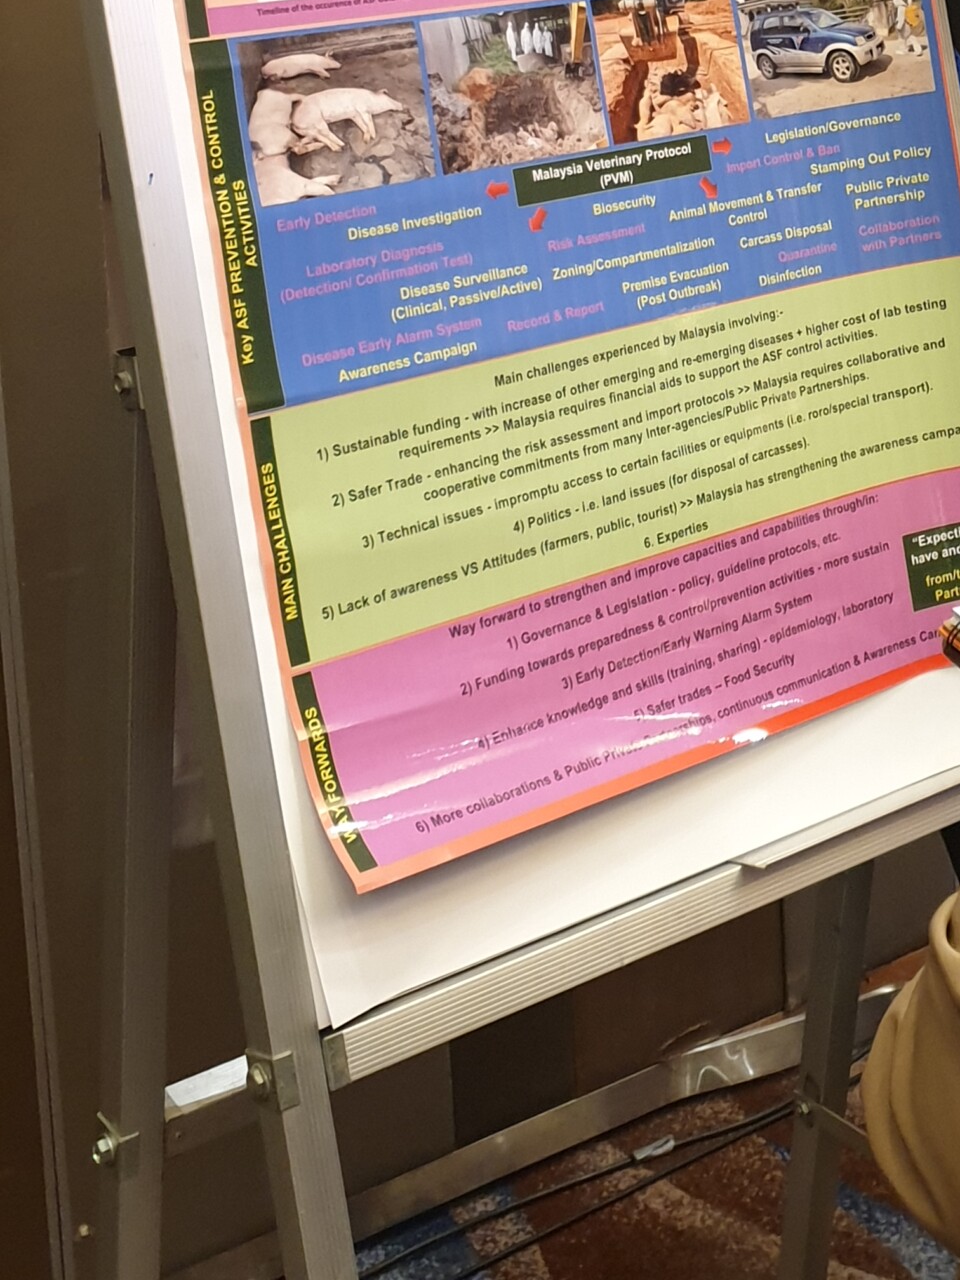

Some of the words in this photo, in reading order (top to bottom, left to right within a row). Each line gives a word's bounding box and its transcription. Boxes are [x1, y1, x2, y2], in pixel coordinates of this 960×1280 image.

[202, 89, 224, 169] CONTROL
[765, 111, 901, 144] Legislation/Governance
[532, 163, 583, 182] Malaysia
[585, 152, 643, 172] Veterinary
[646, 142, 691, 161] Protocol
[763, 150, 803, 166] Control
[806, 148, 814, 157] &
[818, 144, 840, 156] Ban
[810, 156, 865, 175] Stamping
[868, 150, 890, 165] Out
[893, 145, 932, 161] Policy
[214, 173, 226, 185] &
[600, 171, 634, 190] (PVM)
[846, 178, 883, 195] Public
[886, 172, 929, 189] Private
[593, 194, 656, 216] Biosecurity
[669, 203, 707, 222] Animal
[709, 194, 764, 214] Movement
[766, 191, 774, 202] &
[776, 182, 822, 200] Transfer
[855, 188, 925, 210] Partnership
[232, 179, 258, 267] ACTIVITIES
[277, 217, 310, 232] Early
[314, 204, 377, 225] Detection
[347, 222, 399, 241] Disease
[402, 205, 482, 230] Investigation
[729, 208, 768, 226] Control
[859, 214, 940, 237] Collaboration
[216, 190, 244, 294] PREVENTION
[548, 238, 573, 252] Risk
[577, 224, 645, 246] Assessment
[740, 232, 782, 249] Carcass
[785, 220, 833, 240] Disposal
[862, 238, 887, 252] with
[889, 230, 942, 247] Partners
[306, 254, 377, 277] Laboratory
[381, 241, 444, 263] Diagnosis
[553, 236, 715, 281] Zoning/Compartmentalization
[778, 242, 838, 263] Quarantine
[356, 262, 438, 286] Confirmation
[442, 253, 473, 269] Test)
[400, 277, 449, 300] Disease
[453, 264, 528, 289] Surveillance
[622, 275, 668, 294] Premise
[670, 260, 729, 283] Evacuation
[759, 264, 822, 287] Disinfection
[391, 299, 447, 323] (Clinical,
[449, 277, 543, 308] Passive/Active)
[637, 292, 666, 310] (Post
[669, 280, 722, 301] Outbreak)
[234, 299, 250, 329] ASF
[507, 309, 551, 332] Record
[553, 309, 562, 322] &
[565, 301, 604, 321] Report
[242, 335, 254, 365] Key
[302, 346, 355, 367] Disease
[358, 336, 392, 355] Early
[395, 328, 433, 345] Alarm
[436, 317, 482, 337] System
[494, 372, 523, 387] Main
[526, 358, 589, 379] challenges
[593, 338, 660, 363] experienced
[664, 334, 676, 346] by
[679, 321, 726, 342] Malaysia
[339, 357, 410, 382] Awareness
[414, 341, 477, 365] Campaign
[424, 471, 496, 501] cooperative
[500, 450, 580, 480] commitments
[583, 439, 610, 456] from
[613, 432, 642, 449] many
[646, 399, 758, 440] Inter-agencies/Public
[761, 389, 796, 409] Private
[799, 374, 869, 397] Partnerships.
[261, 462, 292, 574] CHALLENGES
[449, 620, 476, 638] Way
[479, 605, 525, 629] forward
[529, 601, 541, 613] to
[544, 580, 607, 608] strengthen
[610, 574, 631, 587] and
[635, 557, 680, 579] improve
[683, 539, 737, 566] capacities
[740, 530, 759, 544] and
[762, 510, 820, 541] capabilities
[823, 494, 879, 524] through/in:
[911, 550, 938, 566] have
[282, 578, 298, 621] MAIN
[305, 707, 341, 804] FORWARDS
